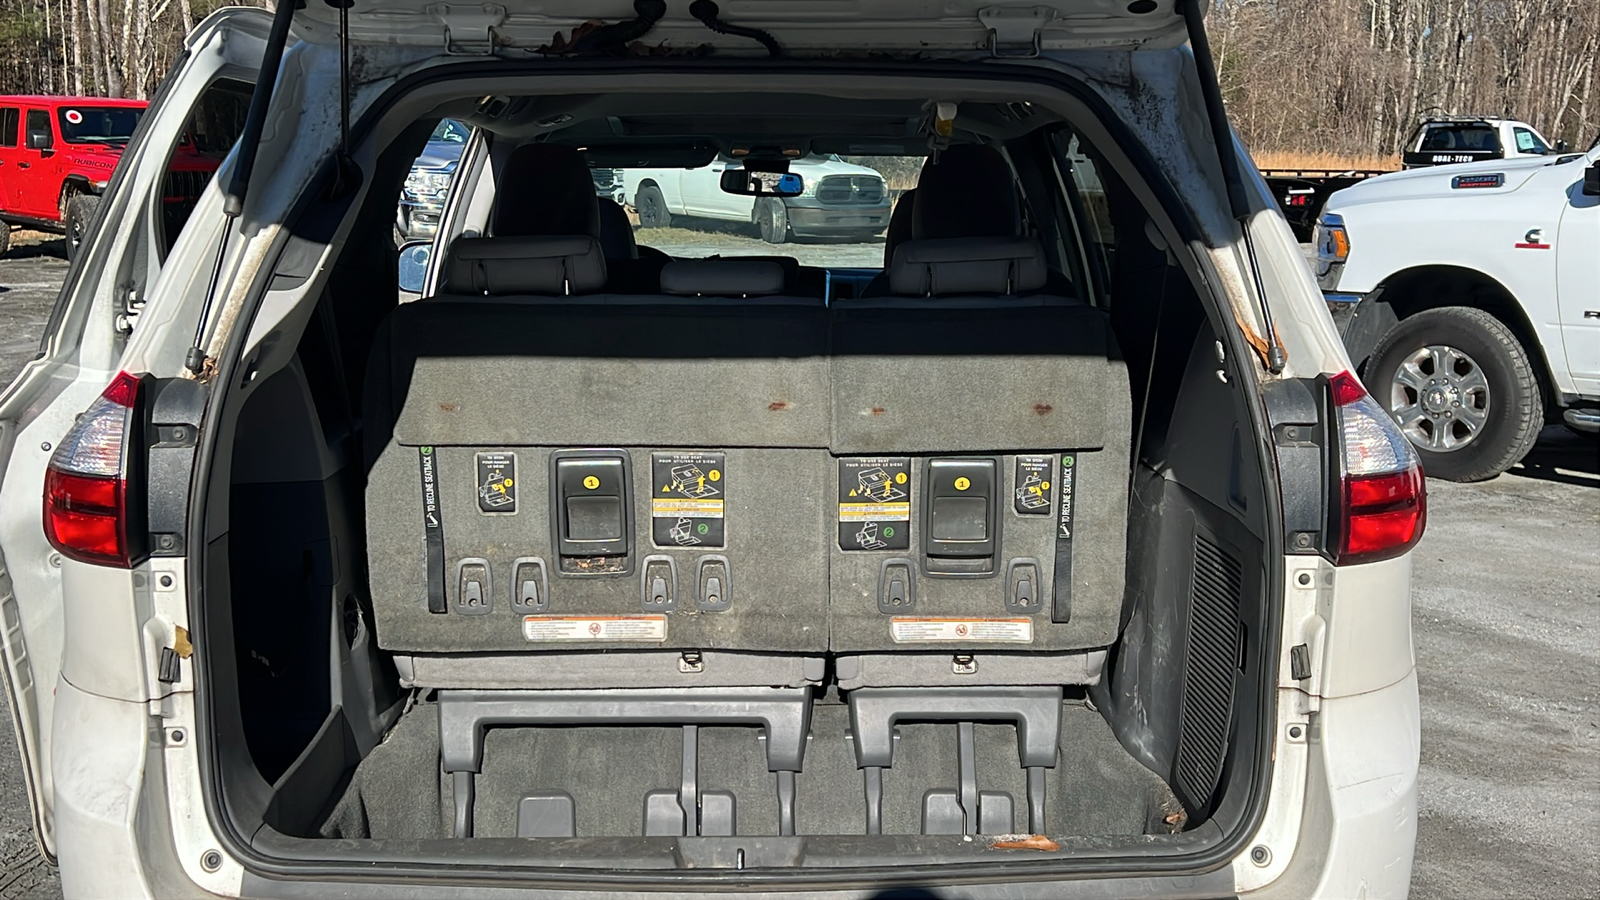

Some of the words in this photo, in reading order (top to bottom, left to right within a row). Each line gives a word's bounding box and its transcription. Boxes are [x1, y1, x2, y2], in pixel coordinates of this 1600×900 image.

[74, 158, 114, 168] RUBICON
[423, 456, 433, 482] SEATBACK
[1063, 468, 1072, 494] SEATBACK
[426, 482, 435, 504] RECLINE
[1062, 494, 1071, 515] RECLINE
